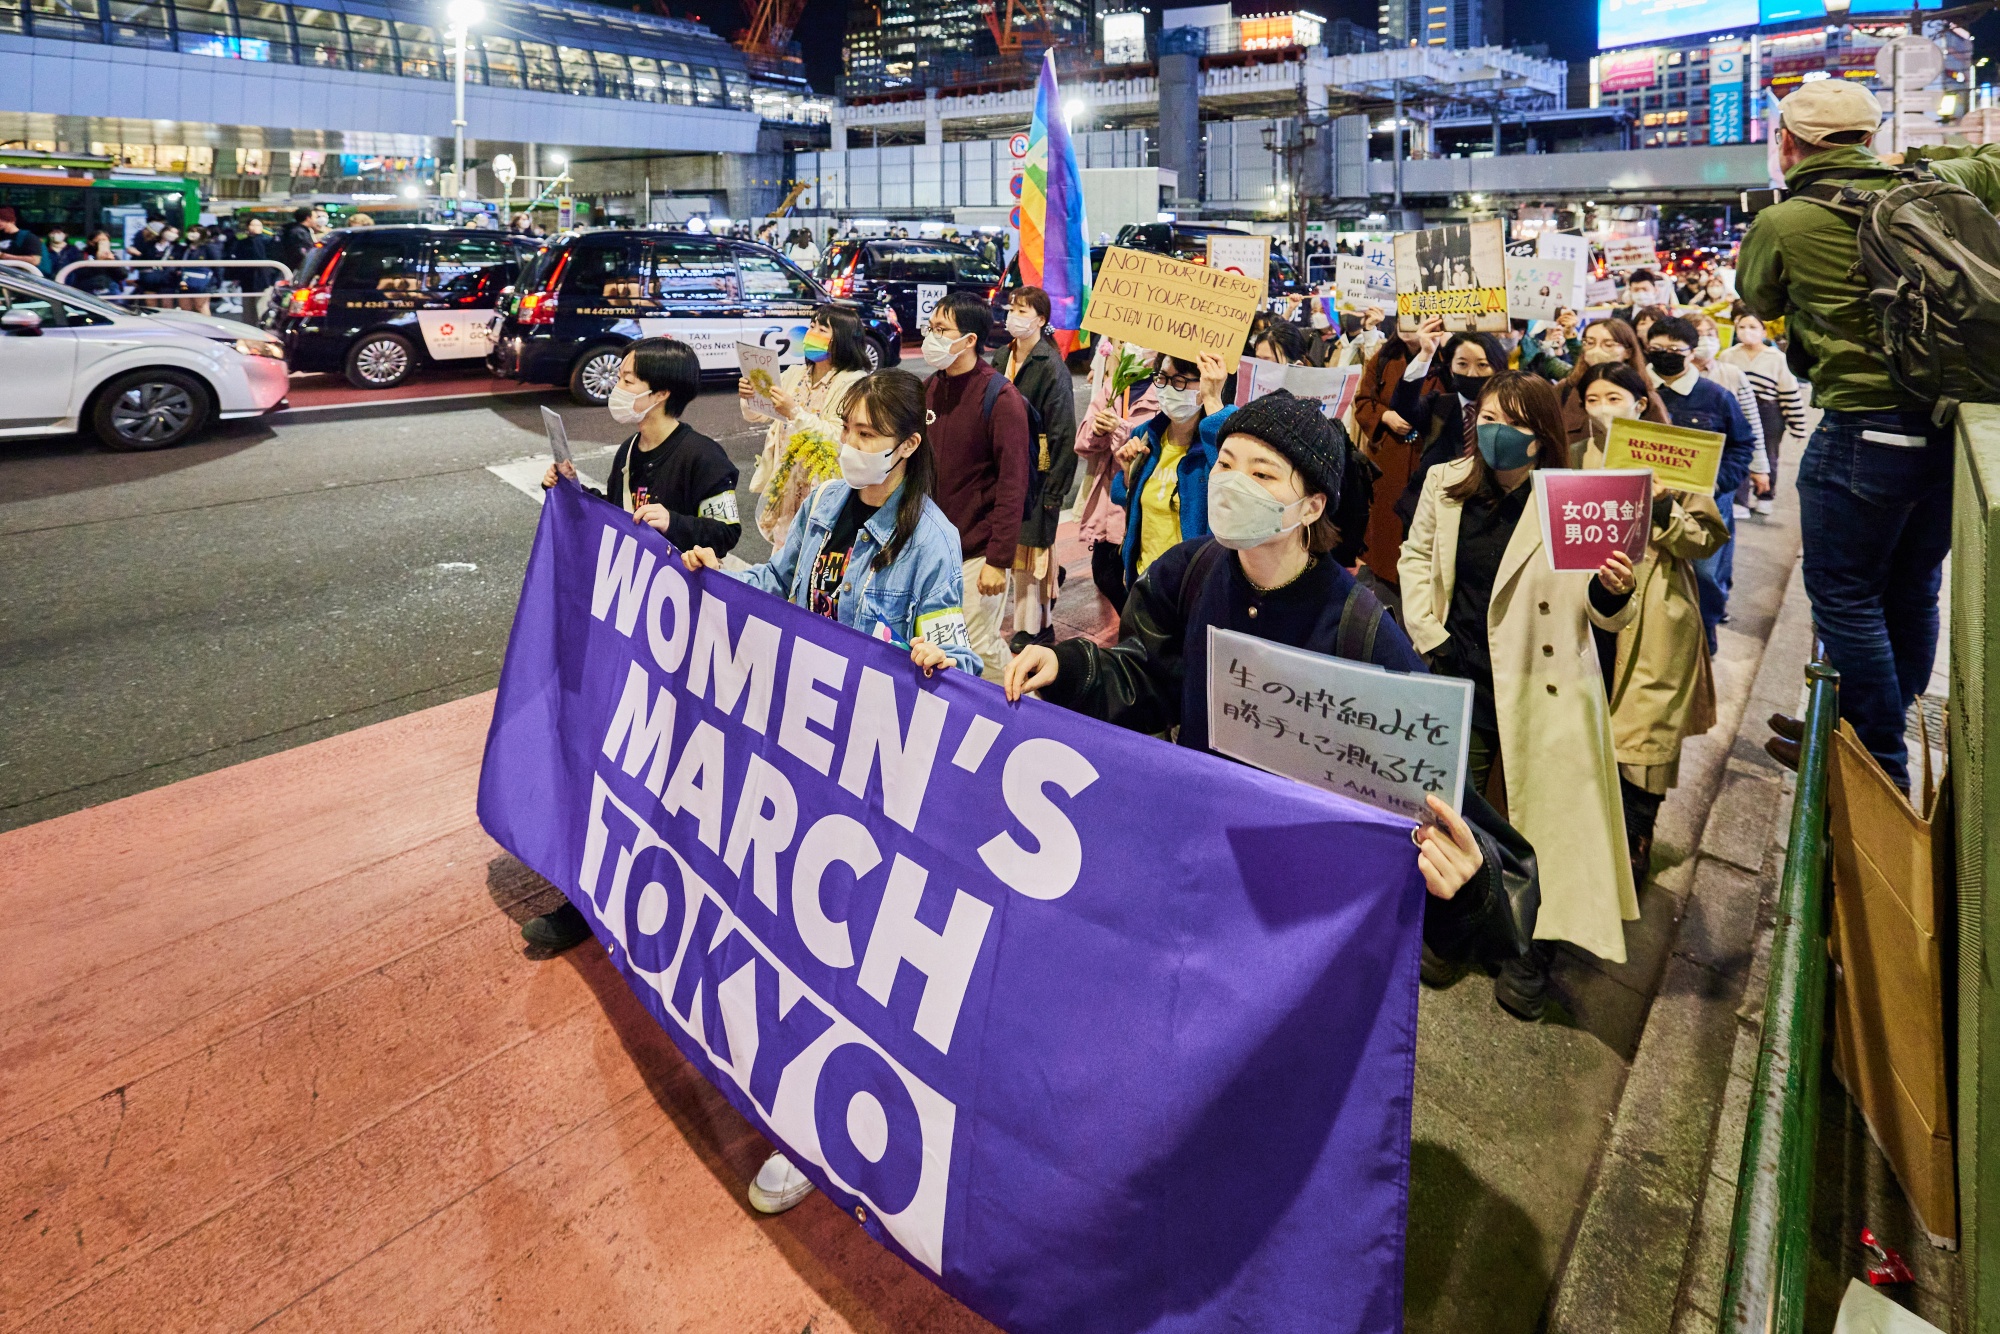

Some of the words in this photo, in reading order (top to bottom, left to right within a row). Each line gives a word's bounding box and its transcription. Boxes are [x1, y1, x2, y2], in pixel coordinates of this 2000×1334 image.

[1107, 251, 1153, 271] NOT
[1157, 259, 1197, 281] YOUR
[1200, 271, 1257, 299] UTERUS
[922, 290, 943, 298] TAXI
[1100, 277, 1144, 299] NOT
[1147, 284, 1190, 308] YOUR
[1190, 297, 1252, 325] DECISION
[1089, 300, 1143, 327] LISTEN
[1147, 312, 1164, 332] TO
[688, 333, 711, 341] TAXI
[715, 342, 735, 350] Next
[742, 351, 773, 367] STOP
[1628, 438, 1700, 459] RESPECT
[1631, 449, 1693, 469] WOMEN
[590, 523, 1100, 901] WOMEN'S
[1229, 658, 1450, 746] 生の枠組みを
[1323, 770, 1335, 782] I
[1343, 780, 1377, 799] AM
[602, 662, 994, 1055] MARCH
[600, 794, 924, 1216] TOKYO
